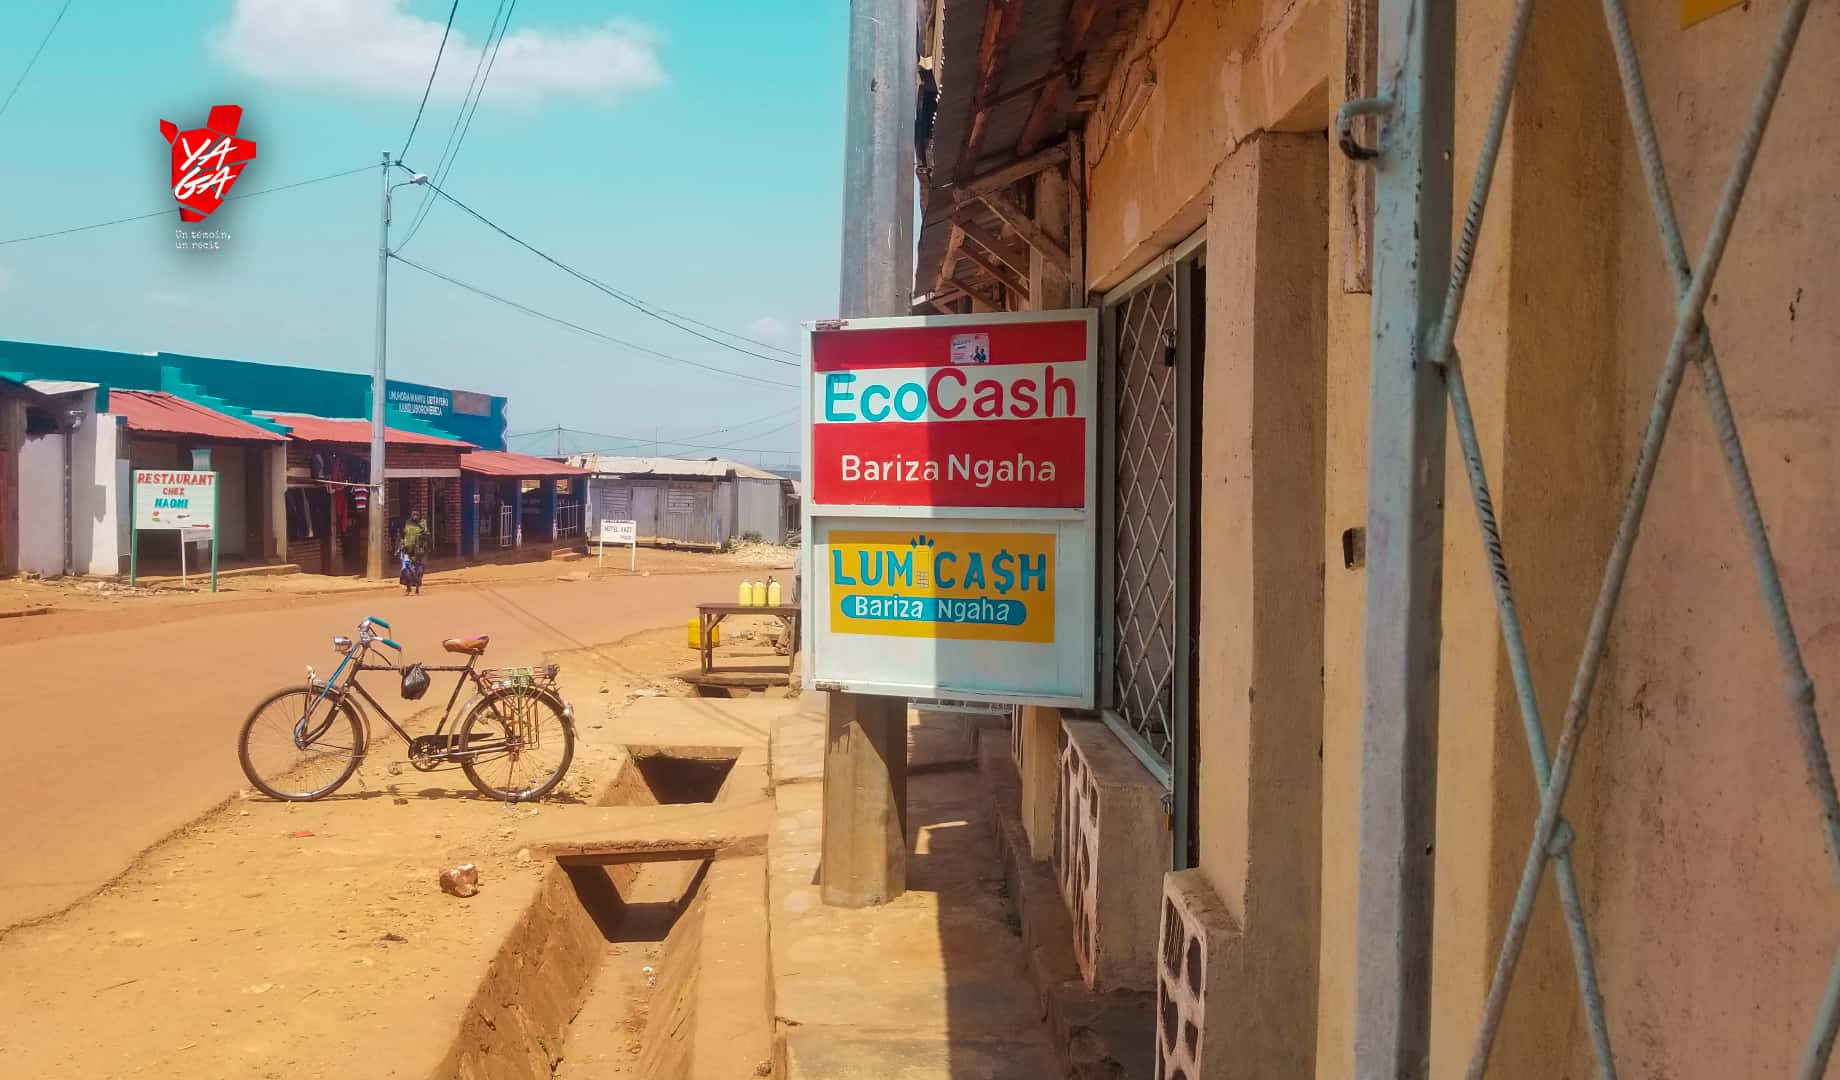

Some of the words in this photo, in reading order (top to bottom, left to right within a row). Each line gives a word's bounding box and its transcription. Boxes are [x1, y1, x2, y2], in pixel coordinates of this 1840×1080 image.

[825, 365, 1076, 422] EcoCash
[137, 473, 214, 485] RESTAURANT
[841, 454, 939, 481] Bariza
[949, 453, 1056, 488] Ngaha
[855, 594, 923, 619] Bariza
[938, 596, 1010, 623] Ngaha
